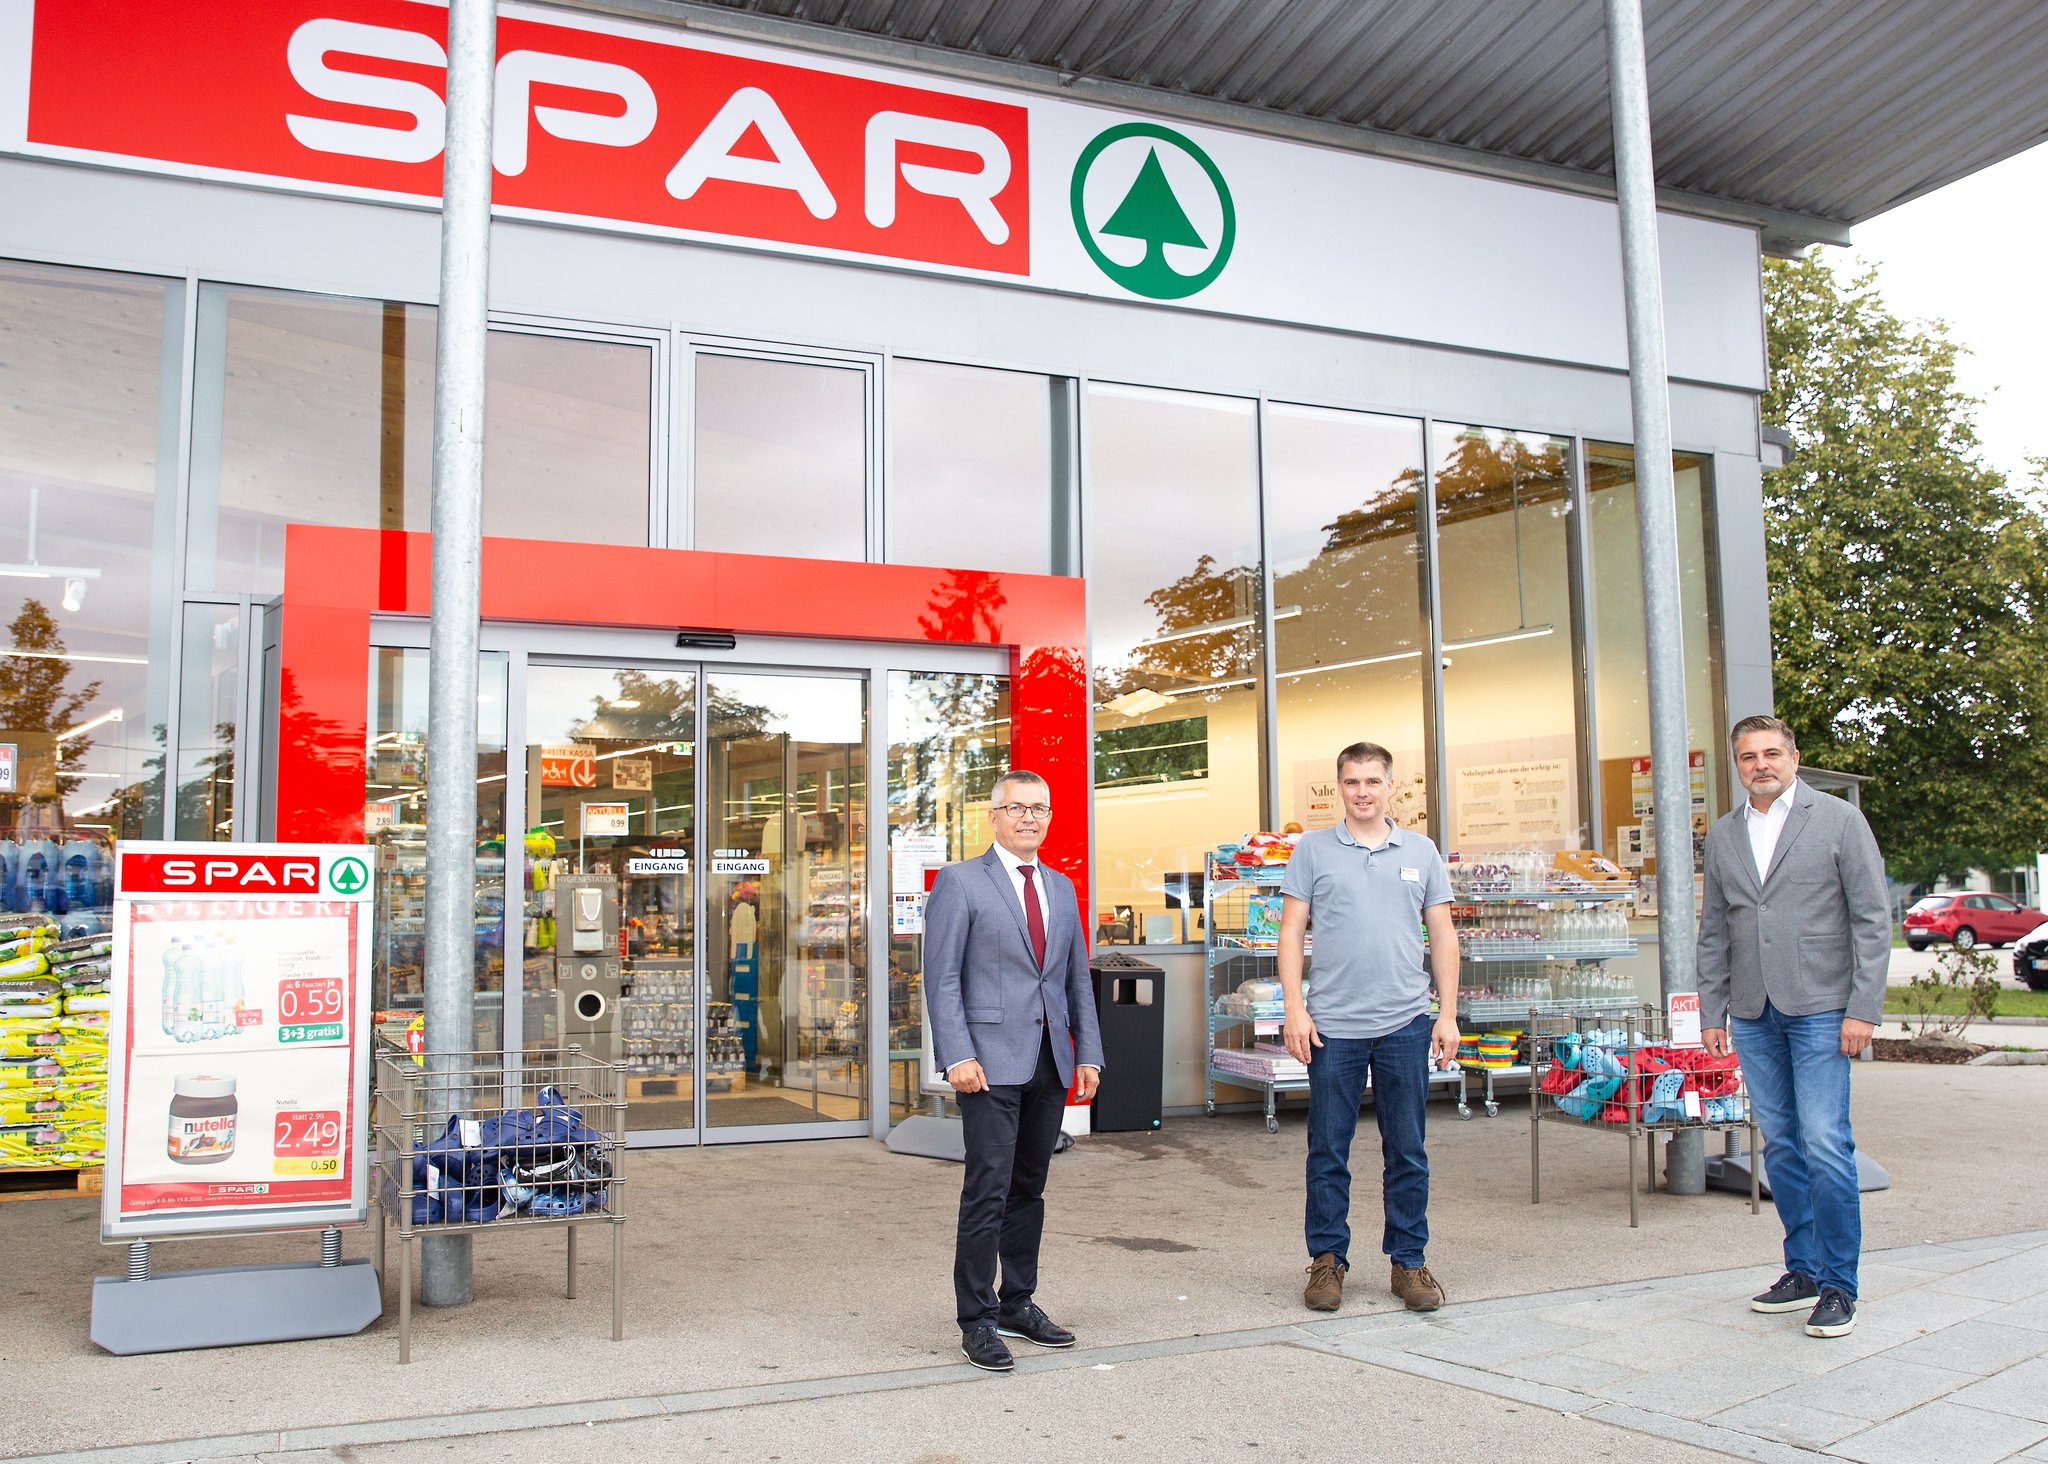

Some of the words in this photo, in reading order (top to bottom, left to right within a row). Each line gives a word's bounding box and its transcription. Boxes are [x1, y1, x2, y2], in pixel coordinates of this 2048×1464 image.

[285, 18, 1012, 246] SPAR
[570, 749, 594, 757] KASSA
[1311, 784, 1335, 797] Nahe
[587, 806, 626, 815] AKTUELL!
[610, 818, 625, 828] 0,99
[634, 862, 684, 871] EINGANG
[716, 863, 765, 871] EINGANG
[163, 860, 316, 887] SPAR
[557, 876, 617, 884] HYGIENESTATION
[286, 981, 294, 989] ab
[326, 979, 336, 988] je
[280, 988, 342, 1017] 0.59
[281, 1027, 305, 1041] 3+3
[307, 1025, 340, 1040] gratis!
[292, 1113, 308, 1121] statt
[309, 1112, 325, 1120] 2.99
[184, 1117, 235, 1133] nutella
[275, 1120, 339, 1148] 2.49
[311, 1159, 337, 1171] 0.50
[218, 1186, 255, 1194] SPAR
